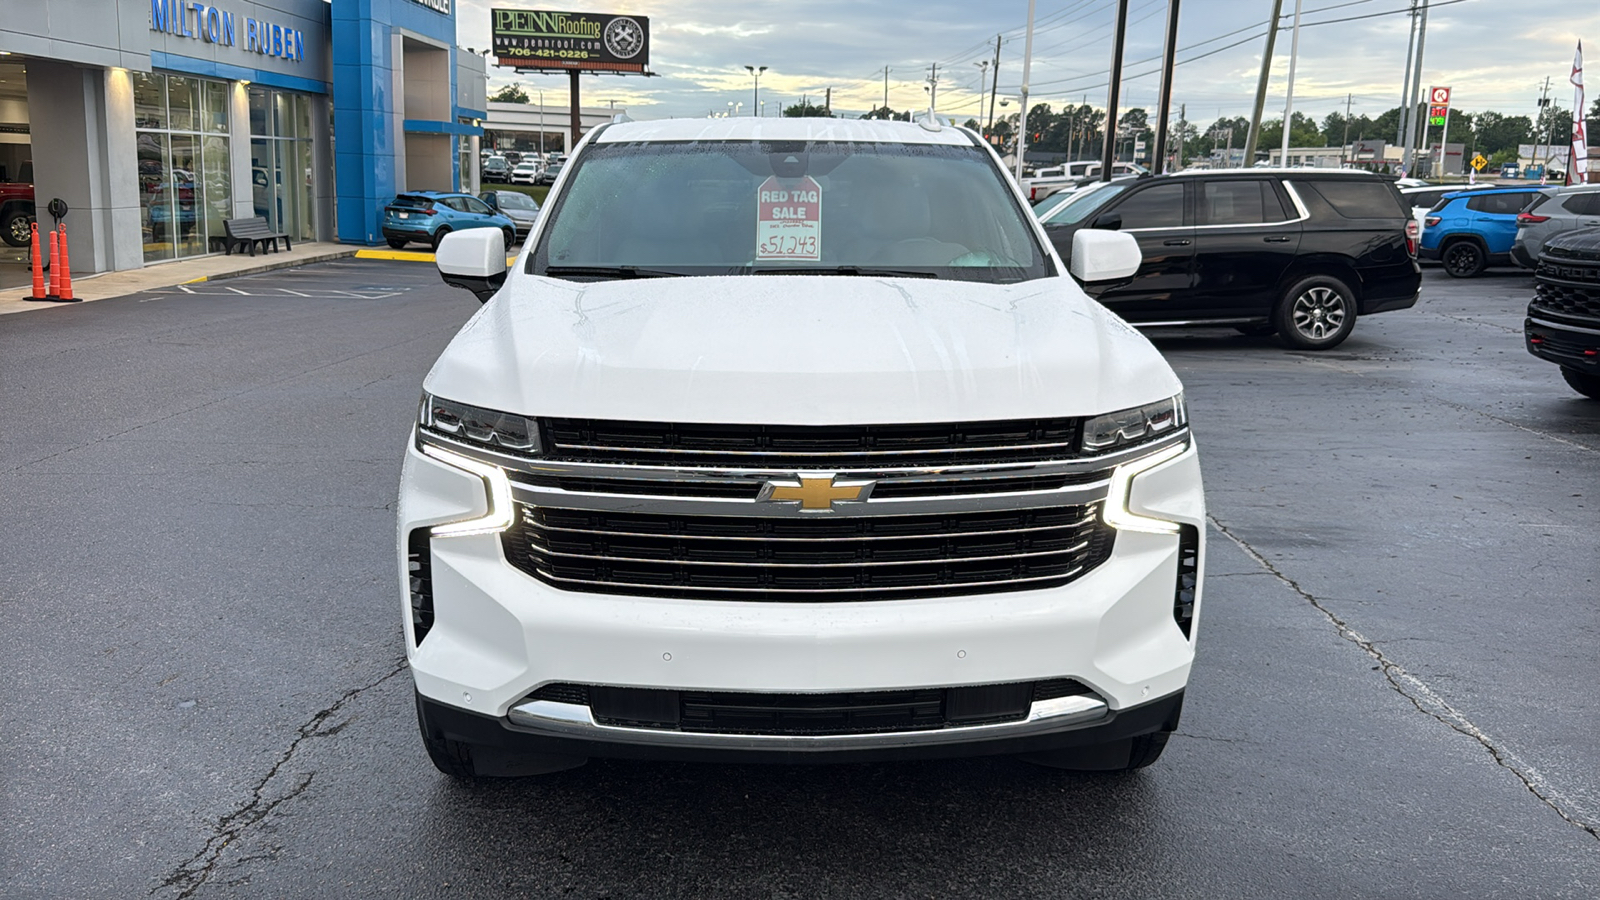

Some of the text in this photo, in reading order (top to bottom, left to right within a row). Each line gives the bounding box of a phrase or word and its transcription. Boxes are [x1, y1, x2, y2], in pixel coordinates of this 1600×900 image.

[151, 0, 304, 61] MILTON RUBEN
[495, 10, 601, 39] PENN Roofing
[495, 37, 601, 50] www.pennroof.com
[508, 47, 589, 59] 706-421-0226
[761, 190, 818, 203] RED TAG
[772, 207, 806, 219] SALE
